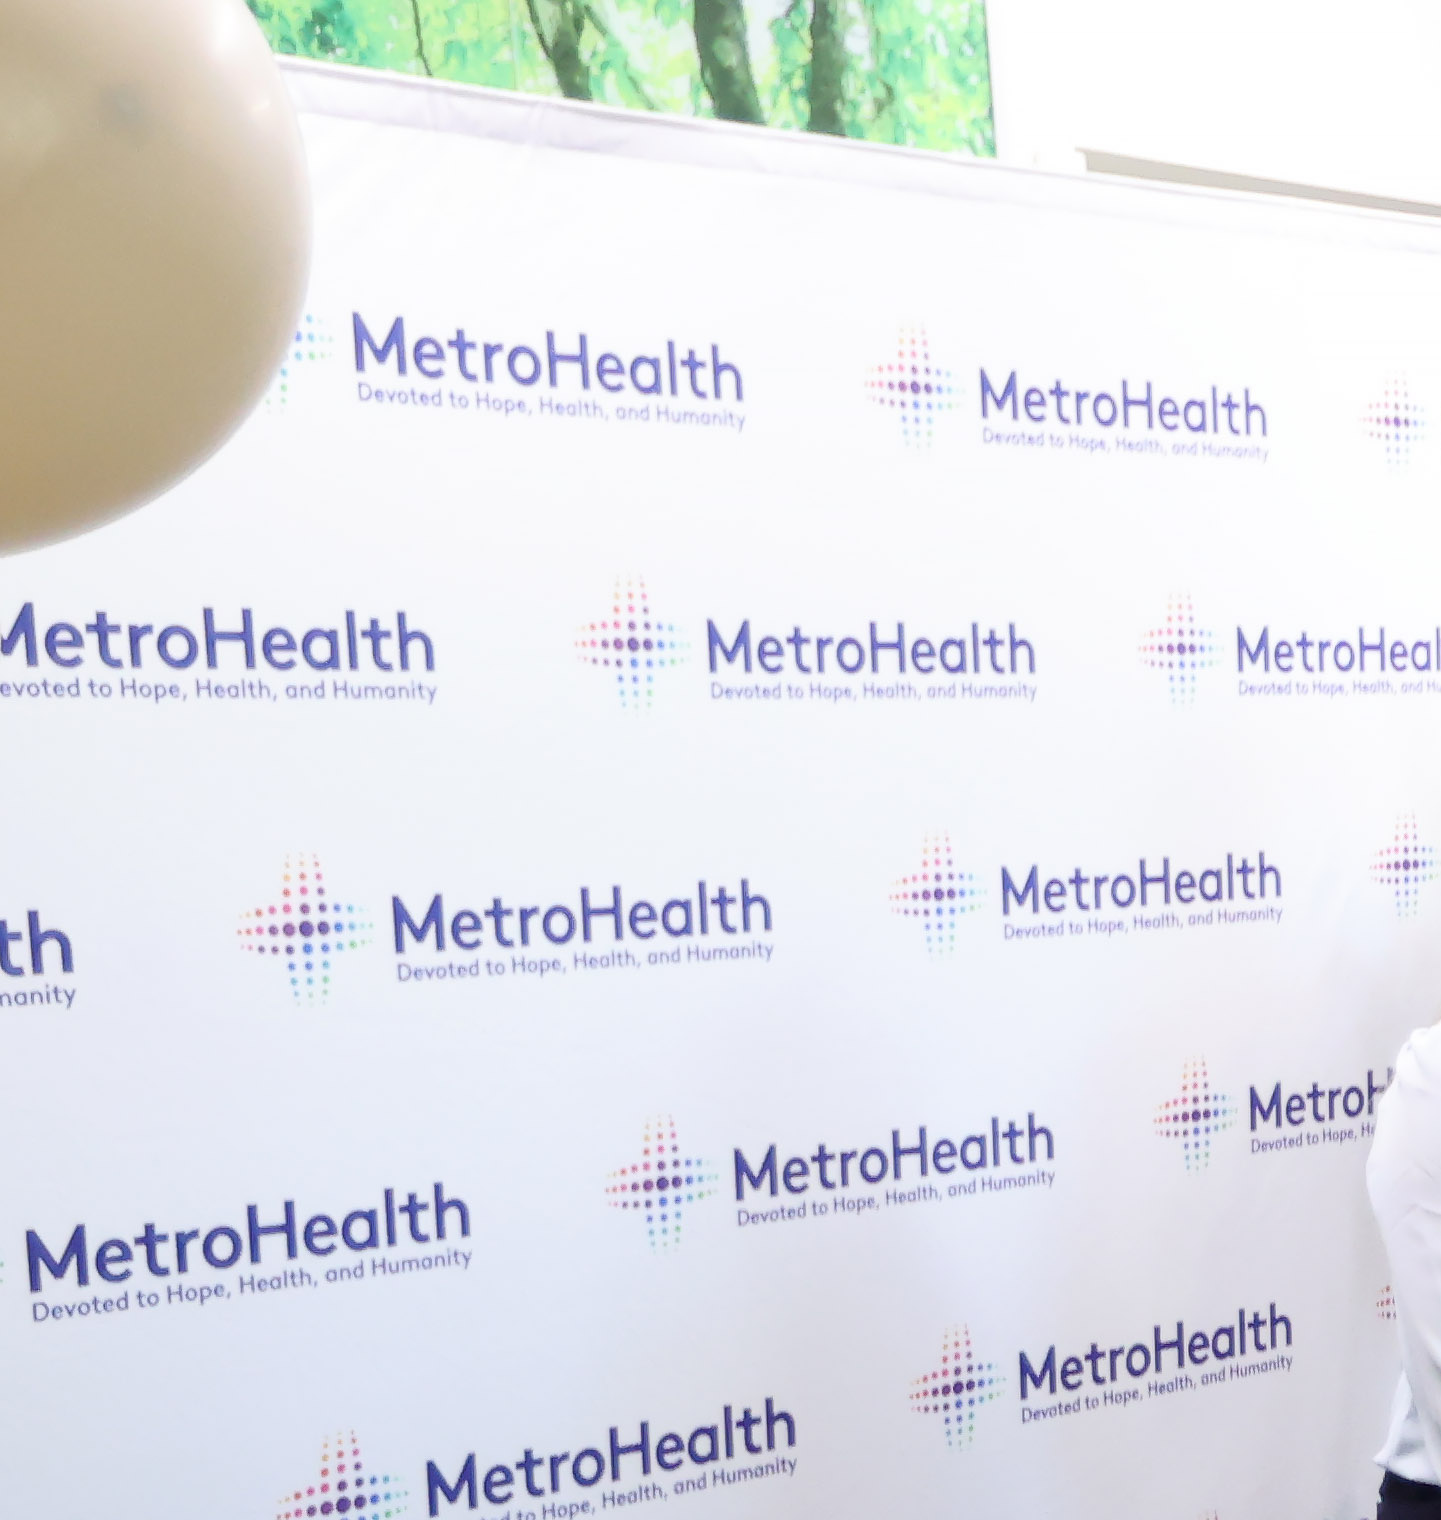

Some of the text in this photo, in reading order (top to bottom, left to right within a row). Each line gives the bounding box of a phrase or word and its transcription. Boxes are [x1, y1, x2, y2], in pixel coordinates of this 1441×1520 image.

[352, 311, 744, 402] MetroHealth
[357, 381, 746, 433] Devoted to Hope, Health, and Humanity
[979, 367, 1267, 437] MetroHealth
[982, 426, 1045, 447] Devoted
[1048, 433, 1065, 449] to
[1171, 441, 1199, 457] and
[1201, 441, 1270, 464] Humanity
[706, 618, 1036, 675] MetroHealth
[0, 677, 437, 705] evoted to Hope, Health, and Humanity
[710, 681, 1037, 703] Devoted to Hope, Health, and Humanity
[1238, 679, 1292, 696] Devoted
[1295, 681, 1309, 696] to
[1400, 679, 1424, 694] and
[1001, 851, 1282, 916] MetroHealth
[391, 878, 772, 954] MetroHealth
[1003, 905, 1283, 941] Devoted to Hope, Health, and Humanity
[396, 940, 774, 982] Devoted to Hope, Health, and Humanity
[733, 1112, 1055, 1202] MetroHealth
[1251, 1132, 1303, 1154] Devoted
[1306, 1132, 1319, 1146] to
[1322, 1127, 1357, 1145] Hope,
[737, 1169, 1056, 1227] Devoted to Hope, Health, and Humanity
[25, 1182, 471, 1294] MetroHealth
[32, 1247, 473, 1323] Devoted to Hope, Health, and Humanity
[1018, 1302, 1293, 1401] MetroHealth
[1021, 1354, 1293, 1425] Devoted to Hope, Health, and Humanity
[426, 1397, 796, 1519] MetroHealth
[541, 1500, 596, 1520] Hope,
[601, 1482, 668, 1509] Health,
[673, 1471, 708, 1495] and
[712, 1456, 797, 1487] Humanity
